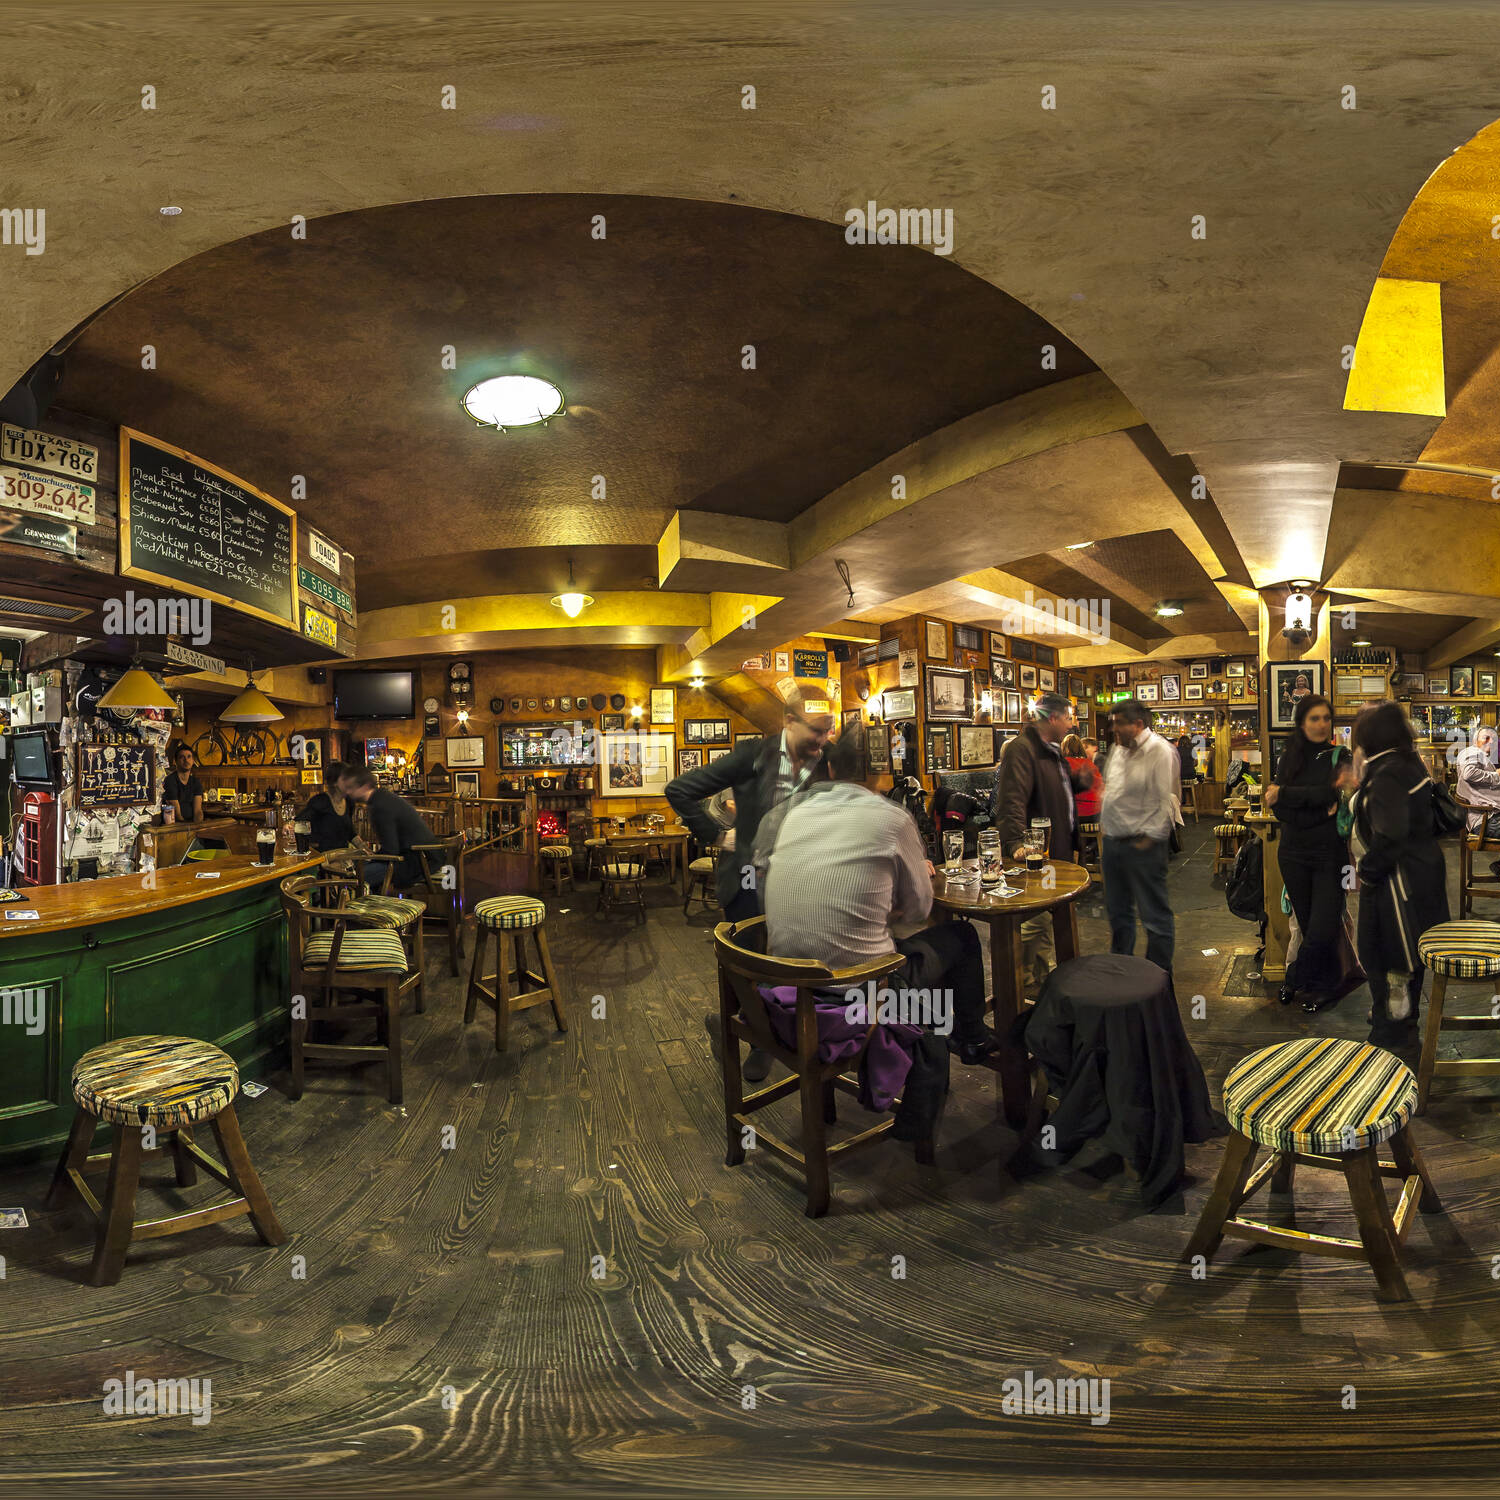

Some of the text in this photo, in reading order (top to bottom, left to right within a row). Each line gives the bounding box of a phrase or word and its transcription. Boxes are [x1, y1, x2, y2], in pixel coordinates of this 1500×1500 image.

[32, 432, 72, 449] TEXAS
[21, 471, 76, 491] Massachusetts
[162, 467, 183, 480] Red
[315, 540, 335, 563] TOADS
[311, 577, 333, 599] 5095
[170, 648, 223, 672] NO SMOKING
